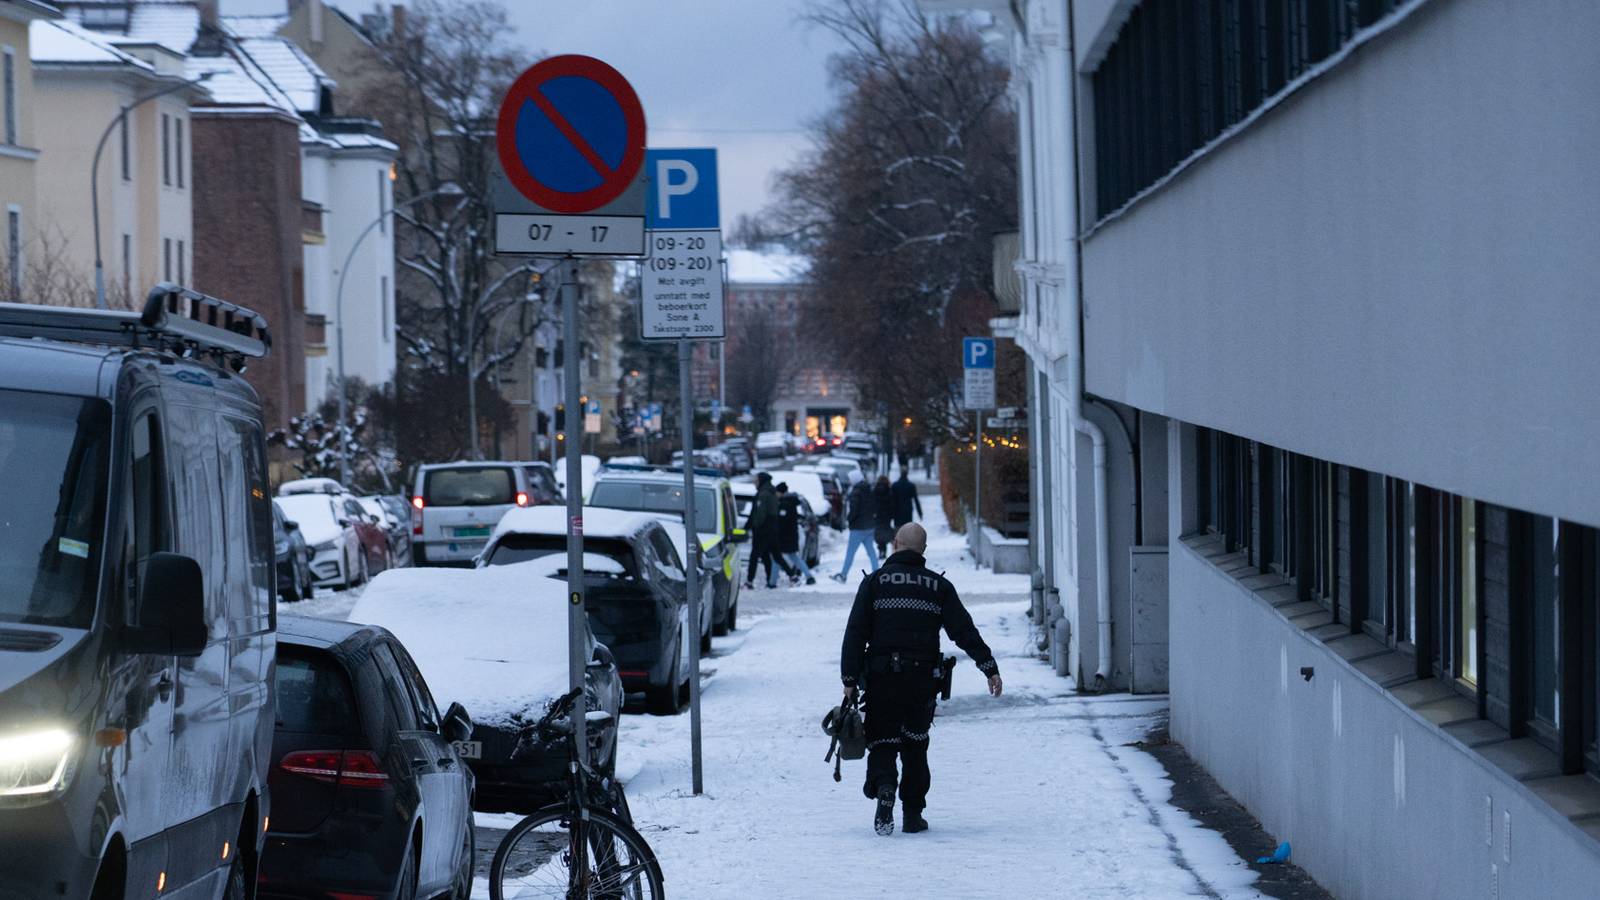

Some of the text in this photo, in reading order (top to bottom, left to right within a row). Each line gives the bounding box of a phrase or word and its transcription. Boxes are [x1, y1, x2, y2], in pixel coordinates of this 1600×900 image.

[656, 159, 699, 218] P
[528, 223, 552, 241] 07
[591, 226, 609, 242] 17
[658, 277, 705, 287] Mot avgift
[655, 292, 710, 300] unntatt med
[658, 303, 708, 311] beboerkort
[667, 313, 689, 321] Sone
[971, 342, 988, 365] P
[879, 572, 939, 592] POLITI
